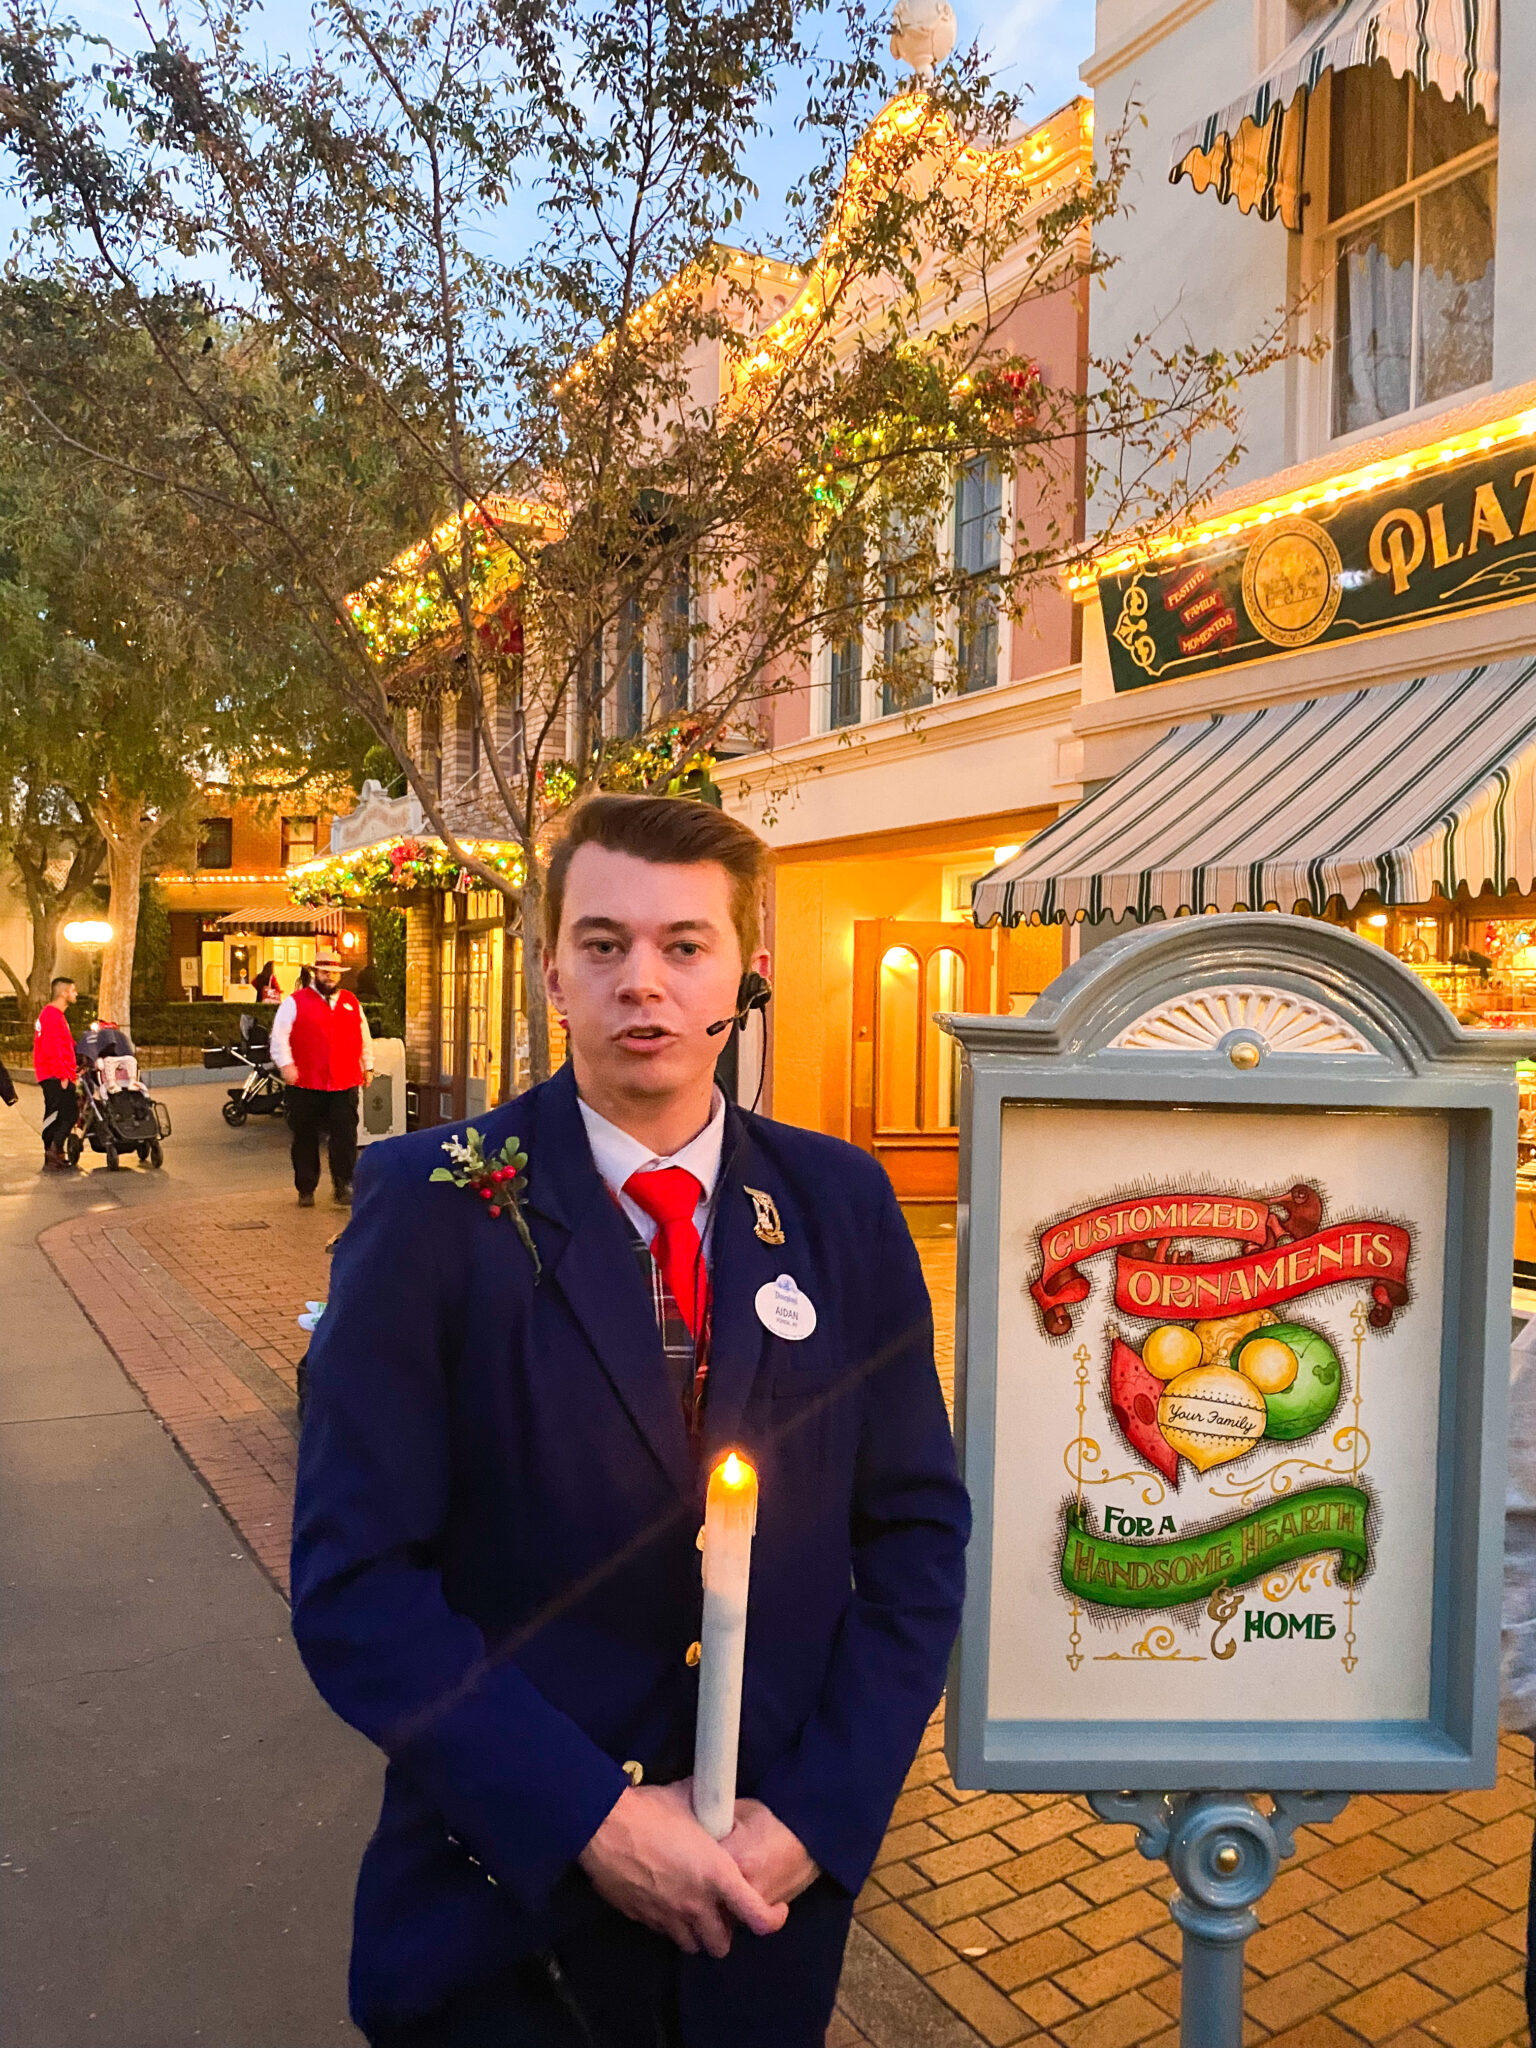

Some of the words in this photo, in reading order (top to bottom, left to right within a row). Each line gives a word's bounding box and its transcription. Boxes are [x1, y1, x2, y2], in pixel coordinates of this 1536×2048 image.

[1183, 592, 1218, 622] FAMILY
[1181, 613, 1234, 652] MOMENTOS
[1049, 1202, 1259, 1262] CUSTOMIZED
[1128, 1231, 1393, 1308] ORNAMENTS
[775, 1306, 799, 1321] AIDAN
[1168, 1403, 1204, 1423] Your
[1207, 1410, 1257, 1435] Family
[1103, 1505, 1154, 1537] FOR
[1157, 1515, 1177, 1535] A
[1073, 1540, 1235, 1591] HANDSOME
[1240, 1502, 1357, 1567] HEARTH
[1207, 1578, 1245, 1660] &
[1243, 1610, 1336, 1643] HOME
